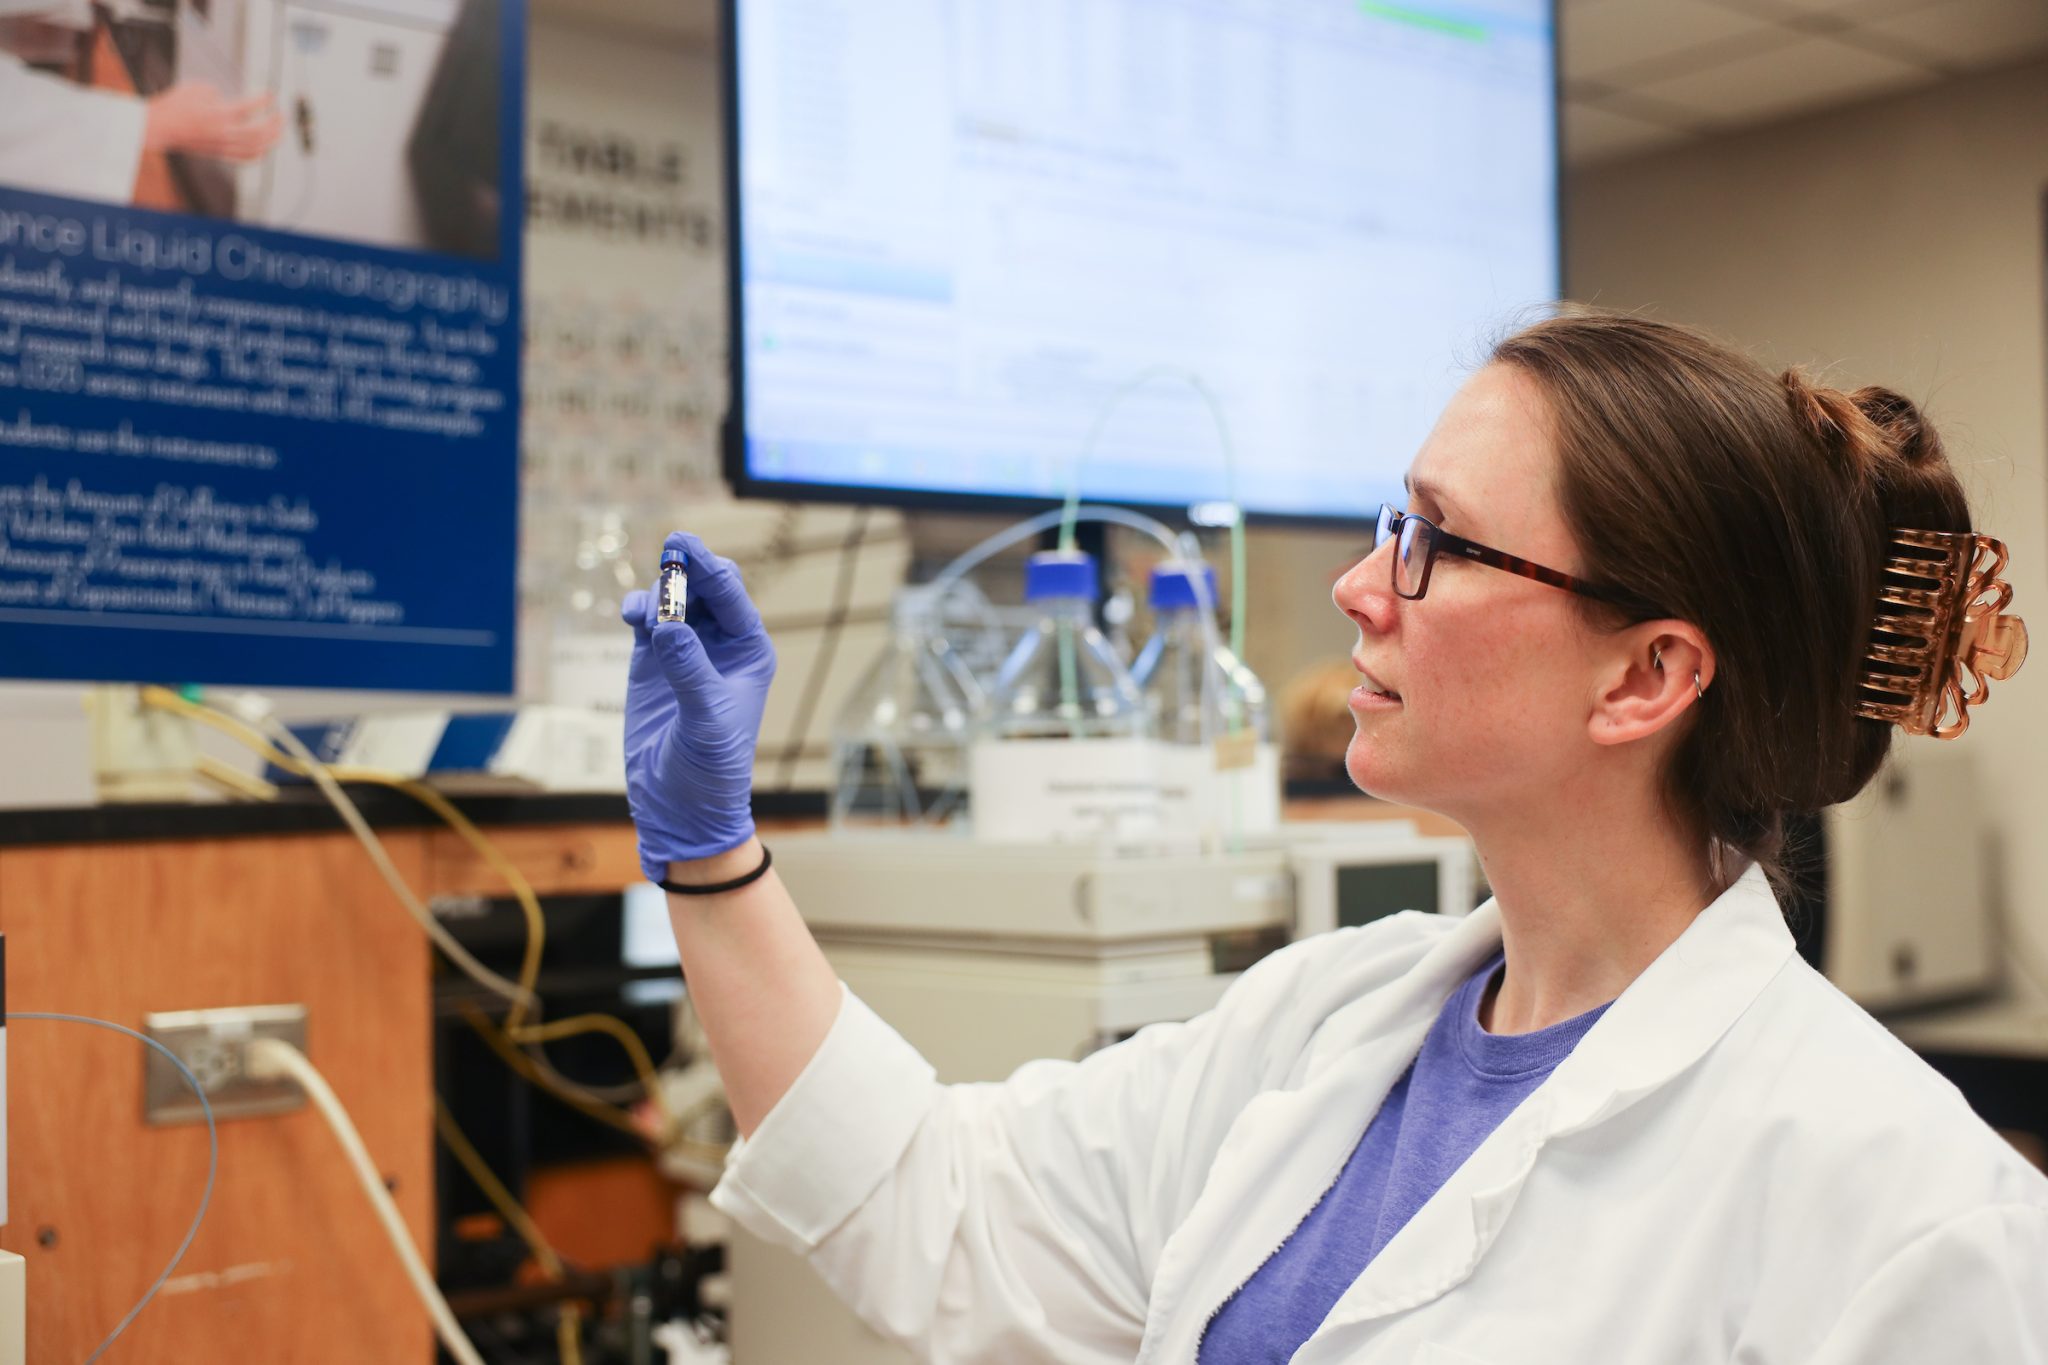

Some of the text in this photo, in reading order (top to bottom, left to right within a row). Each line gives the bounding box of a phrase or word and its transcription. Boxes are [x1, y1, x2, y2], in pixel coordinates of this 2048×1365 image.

[538, 122, 689, 190] TABLE
[95, 218, 209, 272] Liquid
[218, 237, 505, 322] Chromatography
[112, 421, 147, 455] the
[64, 480, 144, 516] Amount
[168, 488, 248, 524] Caffeine
[270, 497, 316, 531] Soda
